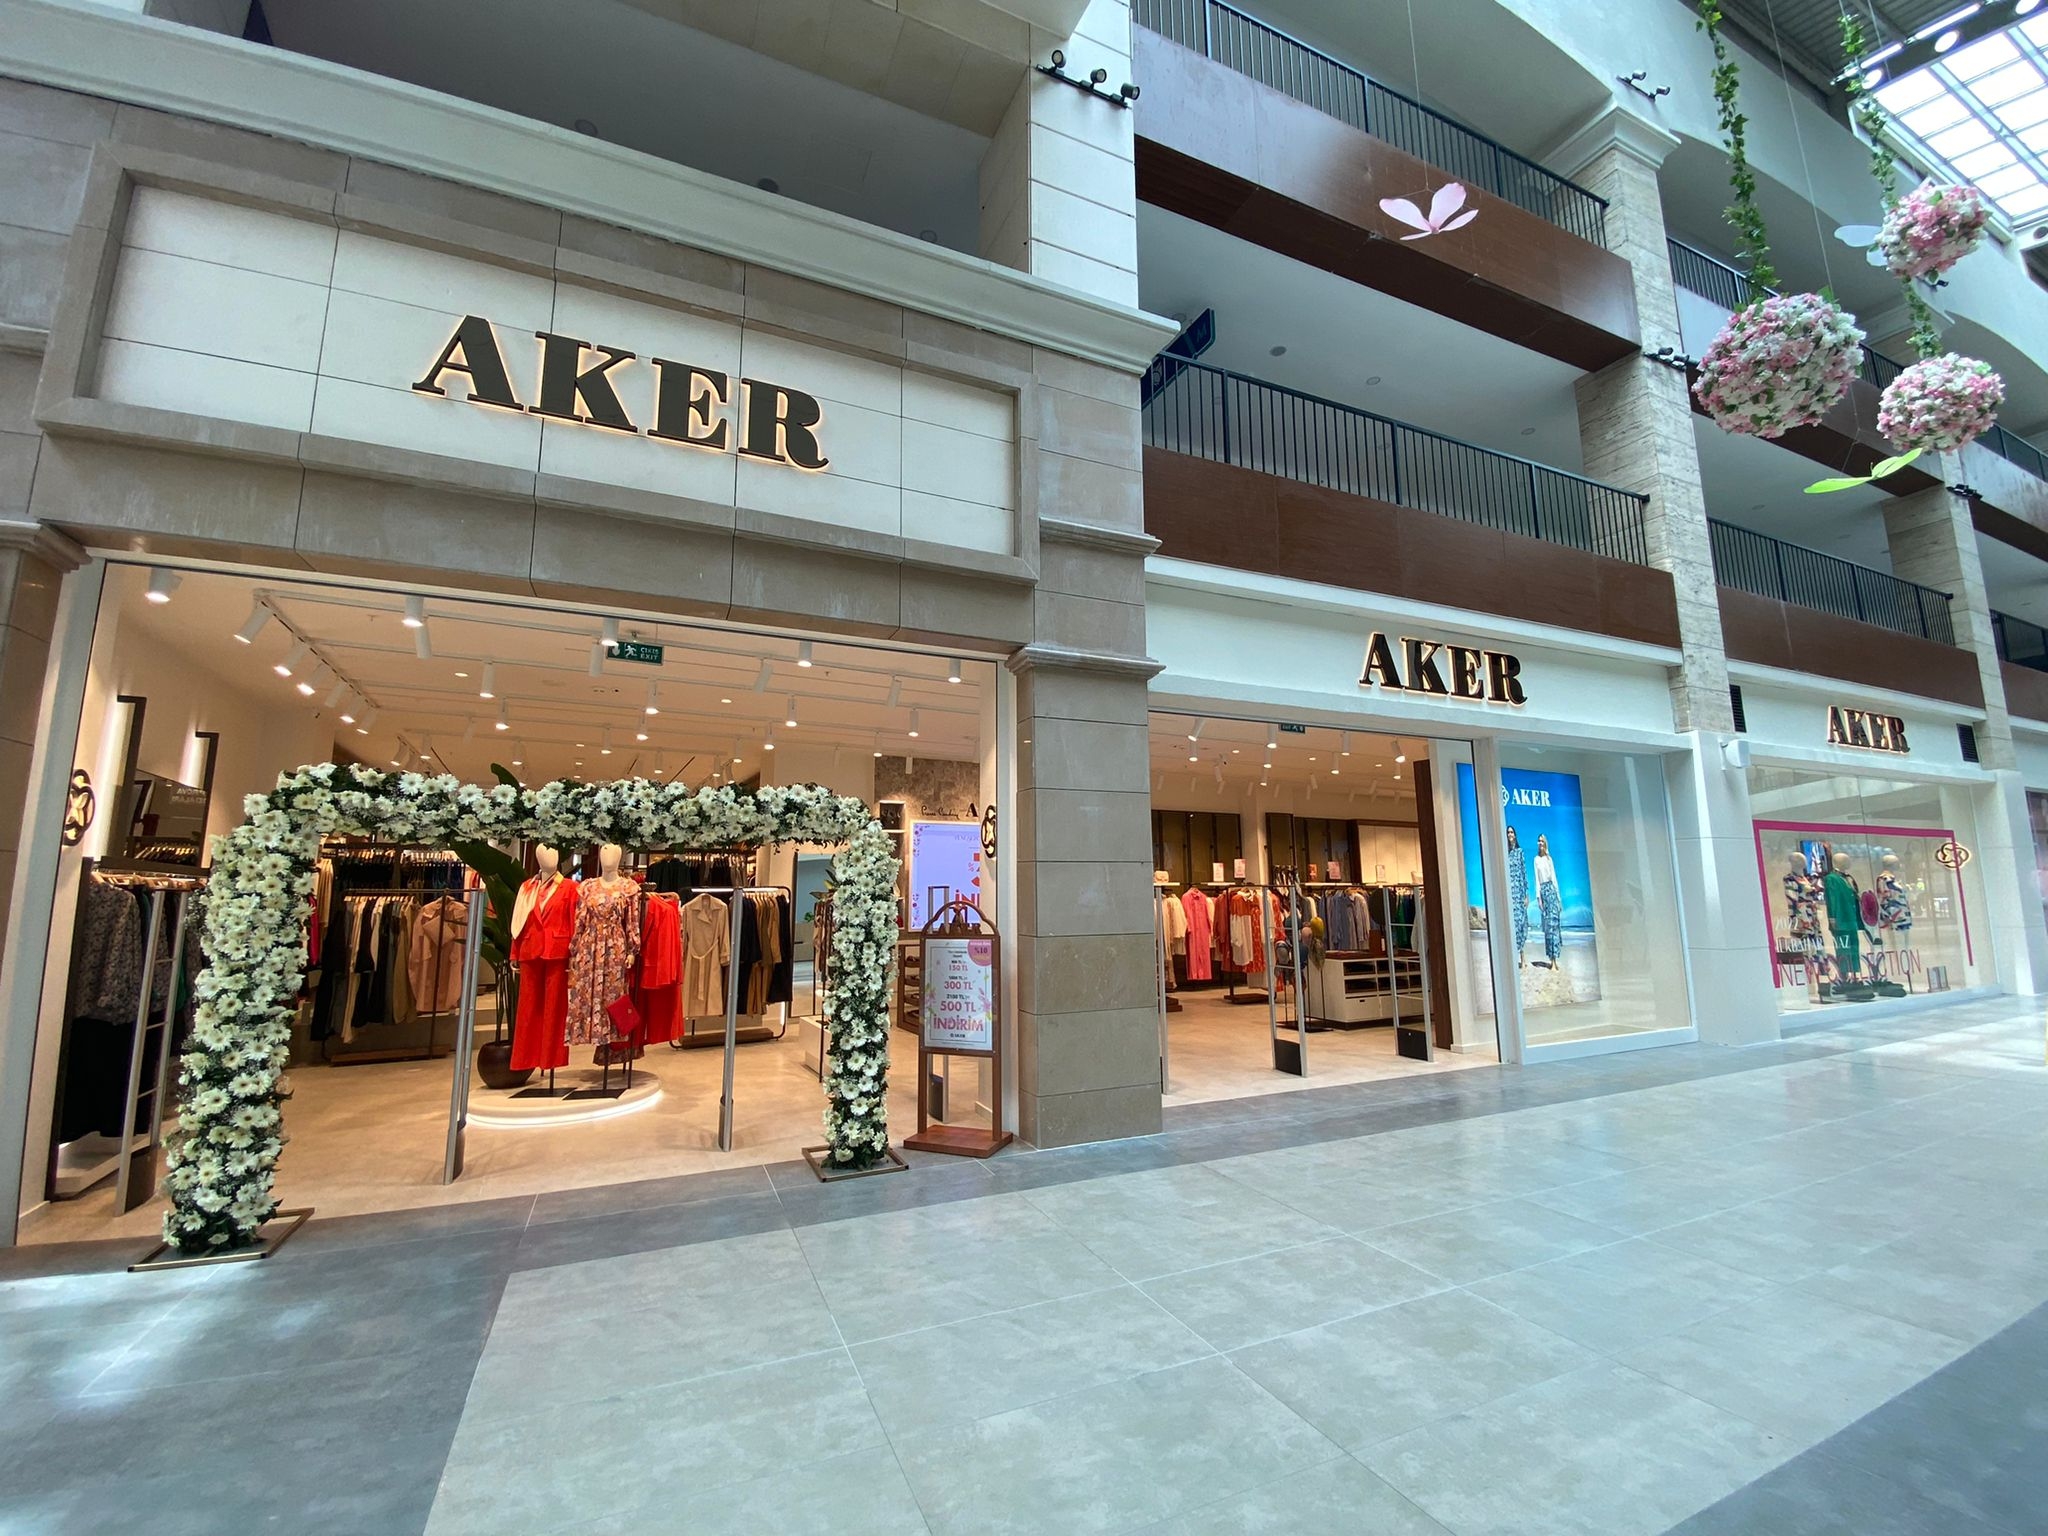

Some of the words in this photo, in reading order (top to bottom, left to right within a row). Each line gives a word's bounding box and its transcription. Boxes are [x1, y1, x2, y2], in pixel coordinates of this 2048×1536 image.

[411, 315, 829, 469] AKER
[1359, 633, 1528, 705] AKER
[1827, 705, 1911, 753] AKER
[1511, 788, 1551, 807] AKER
[1779, 958, 1820, 988] NEW
[944, 981, 962, 990] 300
[963, 981, 973, 990] TL
[940, 1000, 962, 1011] 500
[964, 1001, 976, 1012] TL
[933, 1014, 983, 1031] İNDİRİM
